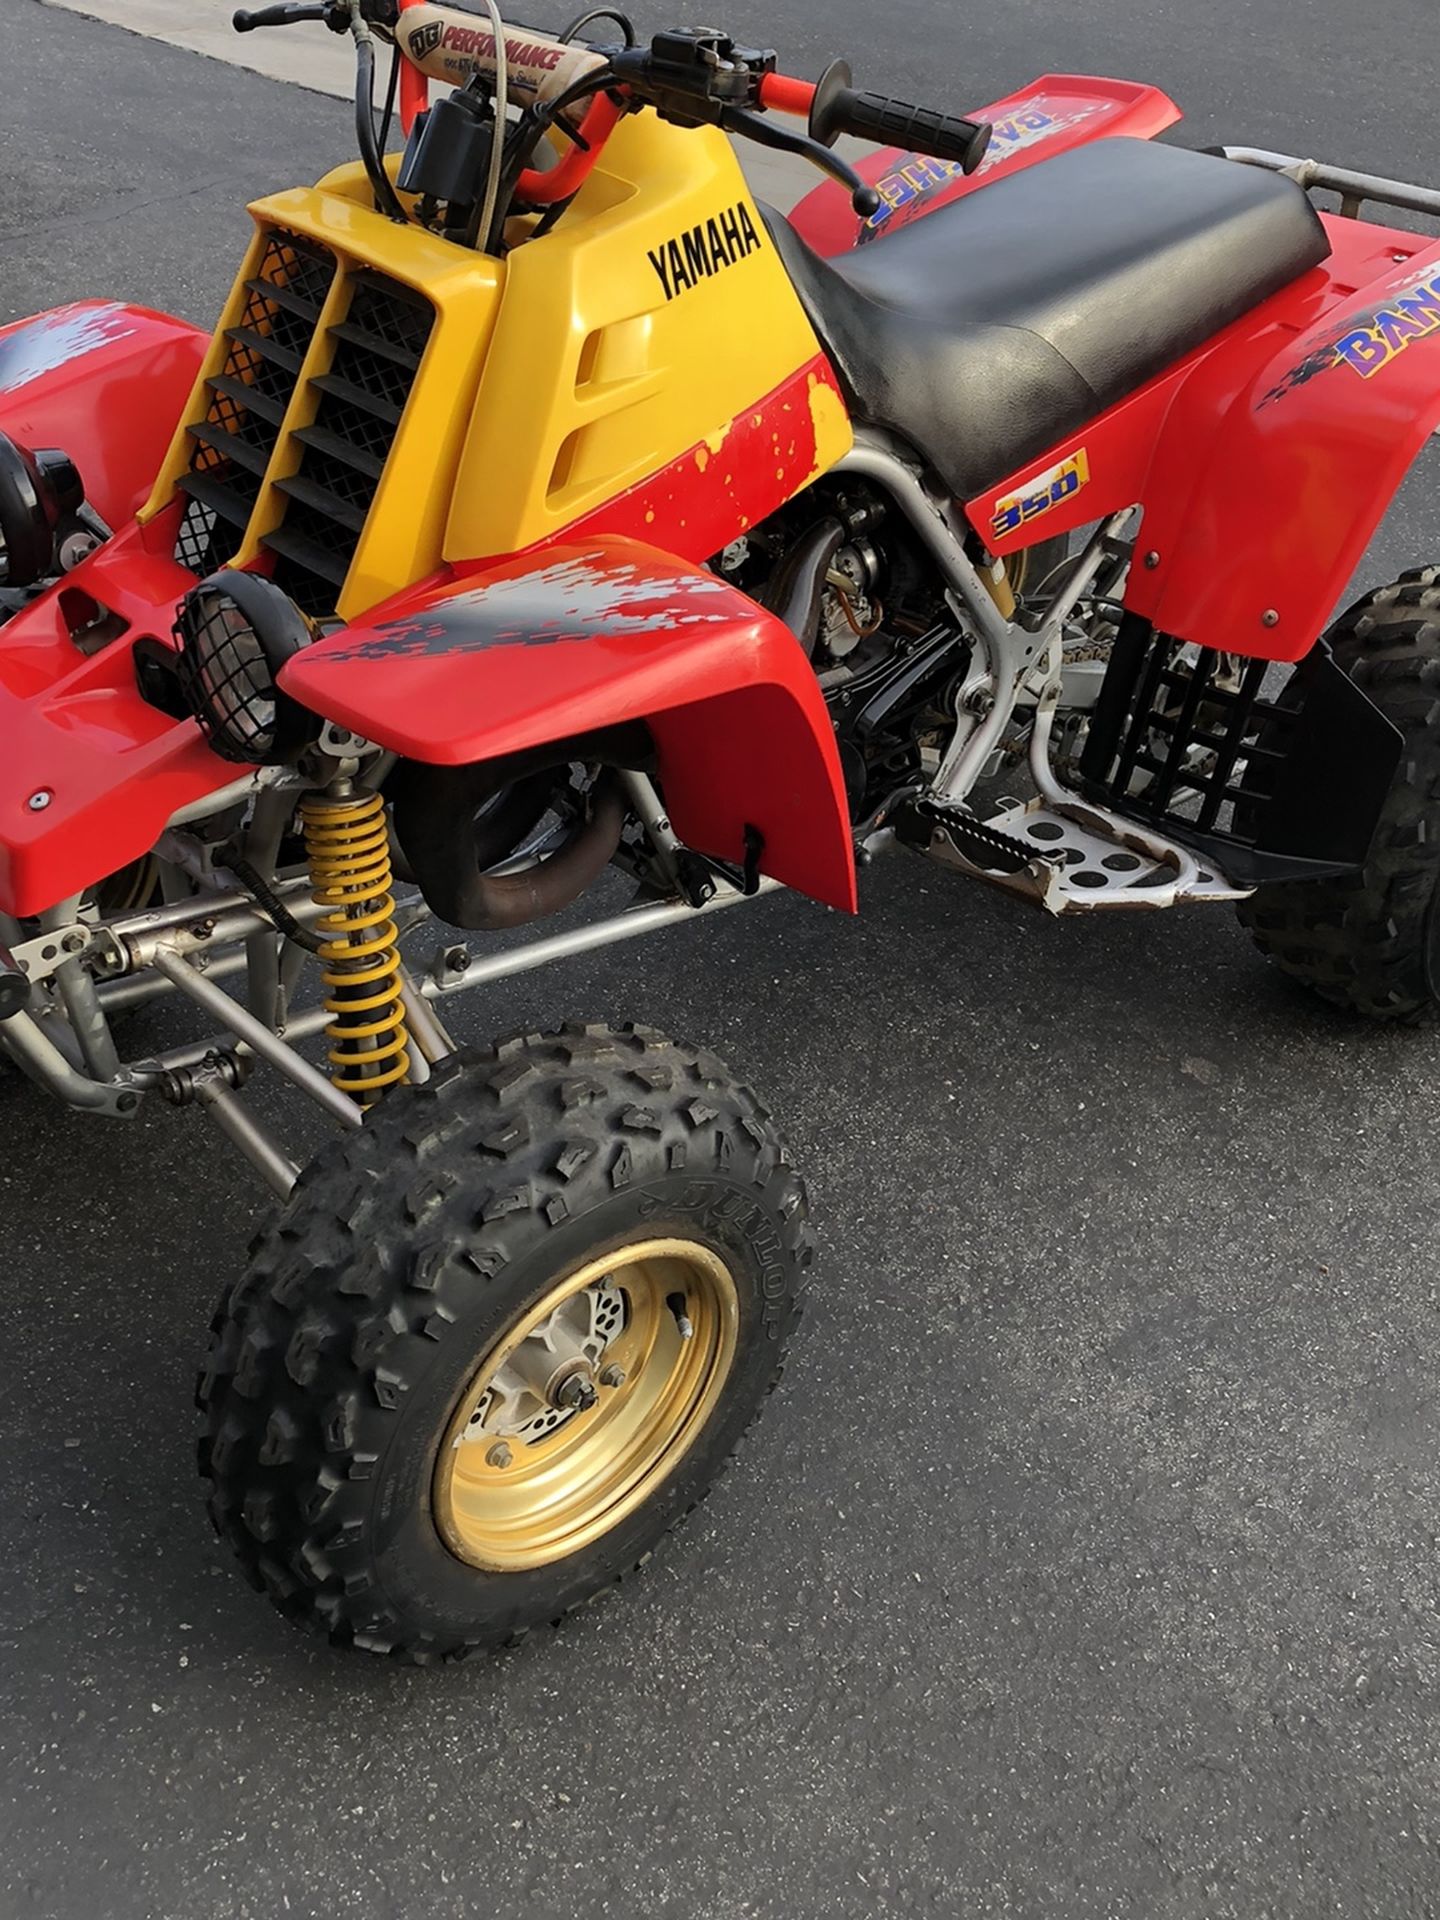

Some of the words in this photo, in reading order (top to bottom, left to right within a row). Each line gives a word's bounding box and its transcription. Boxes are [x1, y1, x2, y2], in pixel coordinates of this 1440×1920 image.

[409, 21, 443, 60] DG
[647, 201, 761, 301] YAMAHA
[990, 468, 1080, 539] 350
[668, 1181, 790, 1340] DUNLOP
